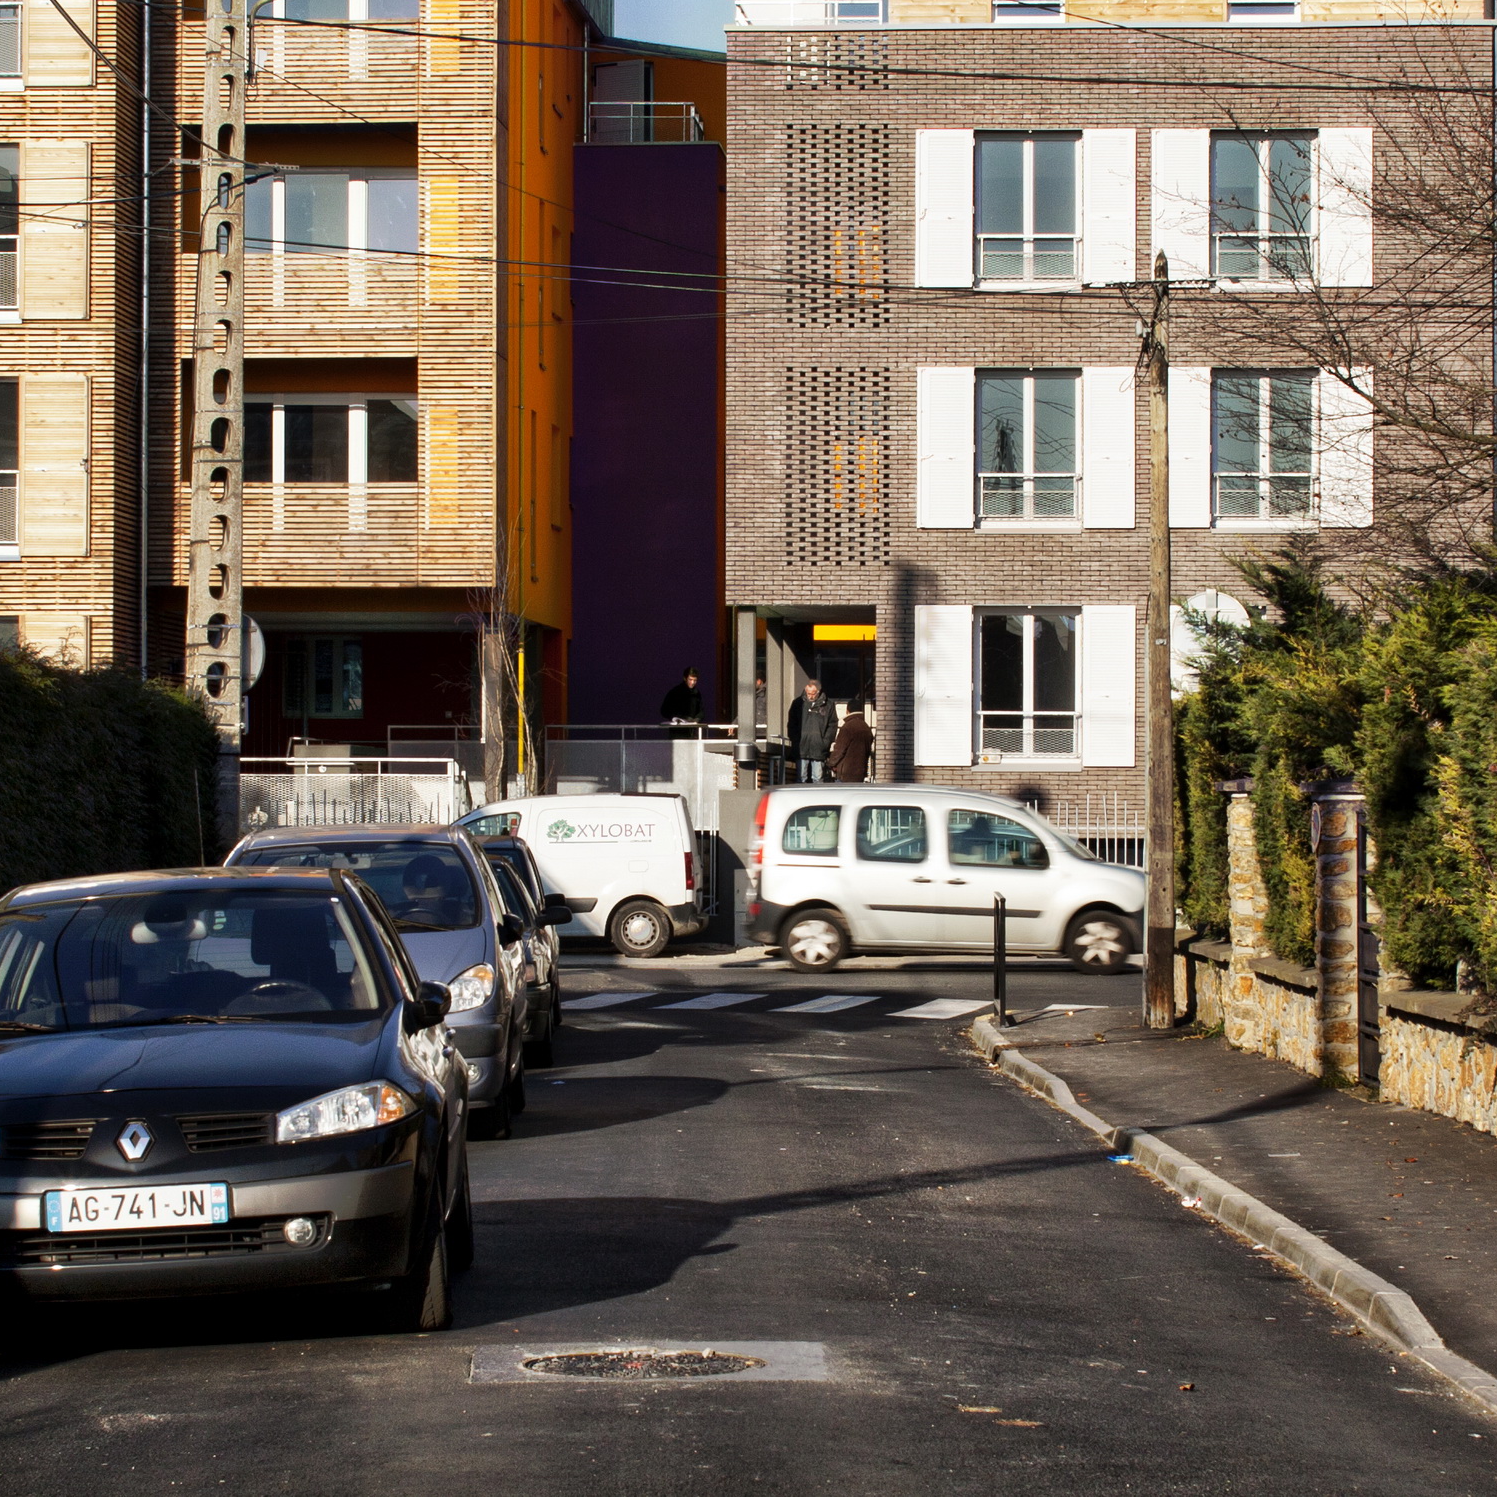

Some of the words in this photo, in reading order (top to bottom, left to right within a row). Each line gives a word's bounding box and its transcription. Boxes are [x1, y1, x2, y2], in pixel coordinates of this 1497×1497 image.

[577, 823, 656, 837] XYLOBAT
[51, 1216, 58, 1226] F
[68, 1190, 205, 1223] AG-741-JN
[212, 1206, 226, 1221] 91
